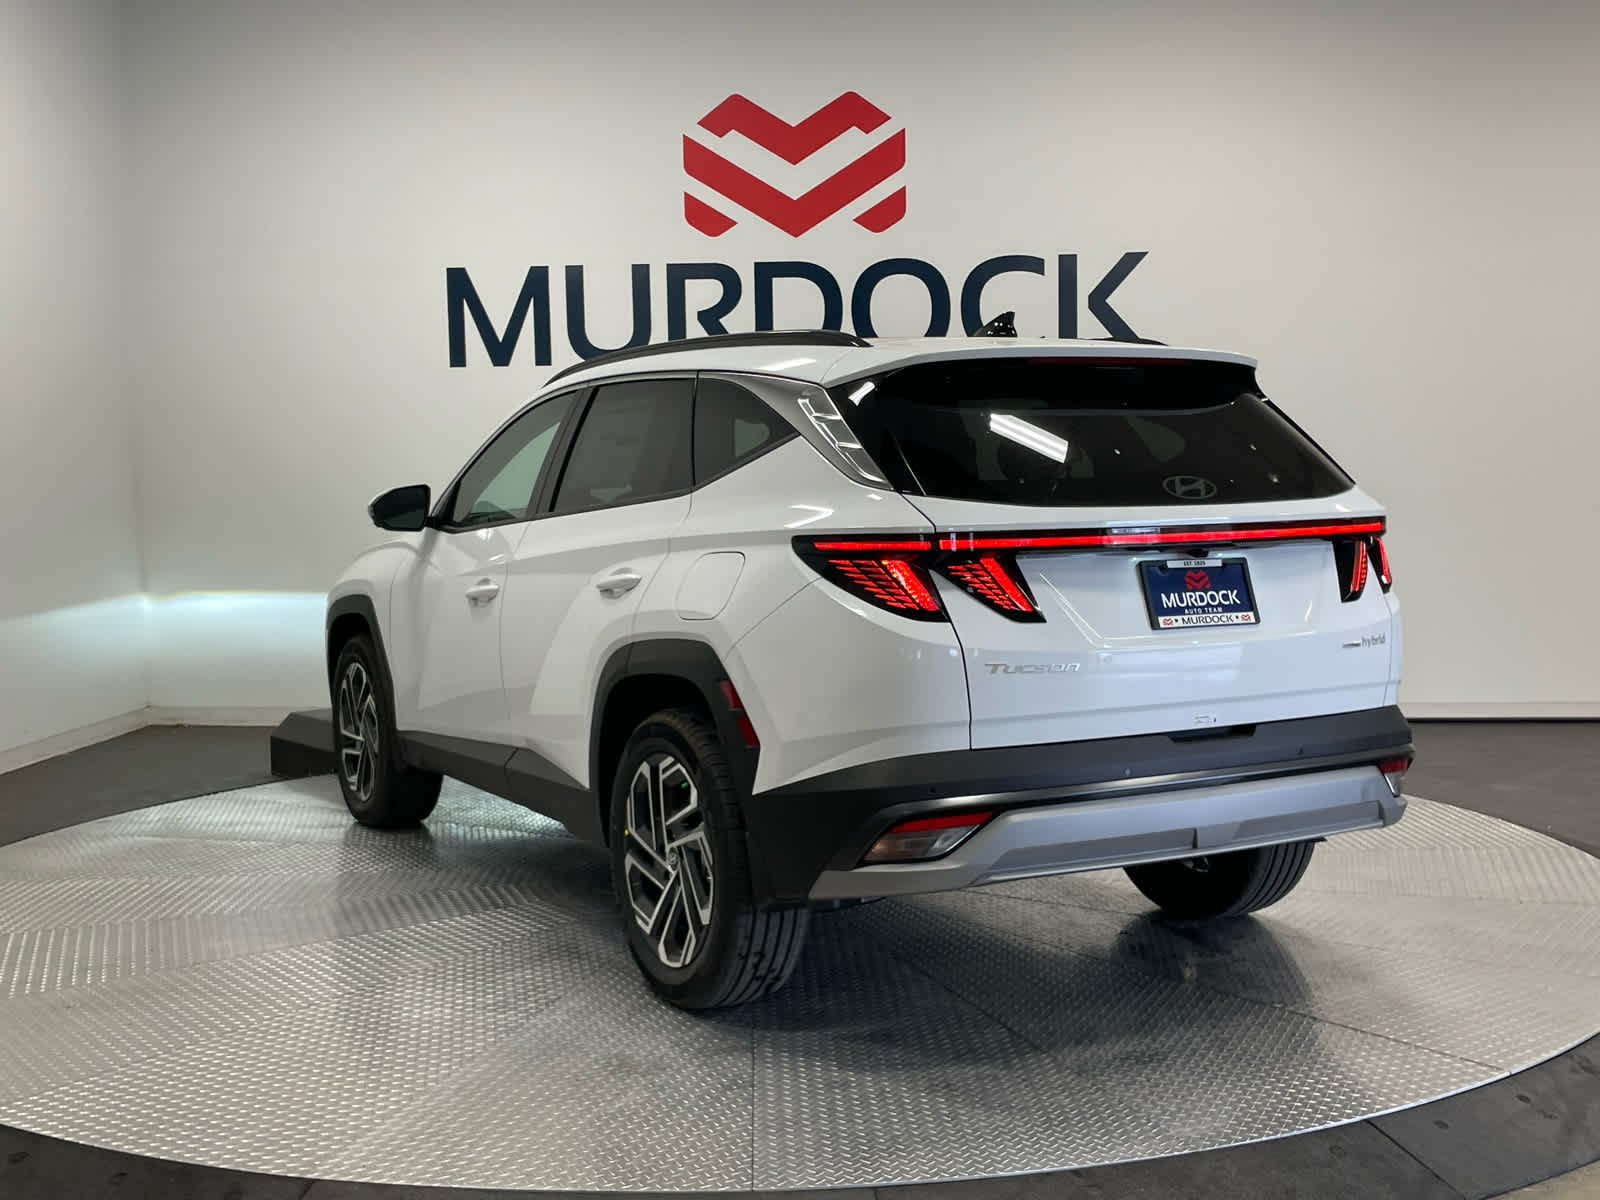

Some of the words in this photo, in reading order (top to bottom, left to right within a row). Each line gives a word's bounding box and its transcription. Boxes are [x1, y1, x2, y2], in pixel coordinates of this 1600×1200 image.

[446, 251, 1149, 368] MURDOCK
[1161, 590, 1241, 609] MURDOCK
[1184, 607, 1203, 615] AUTO
[1181, 614, 1234, 625] MURDOCK
[1361, 632, 1386, 648] hybrid
